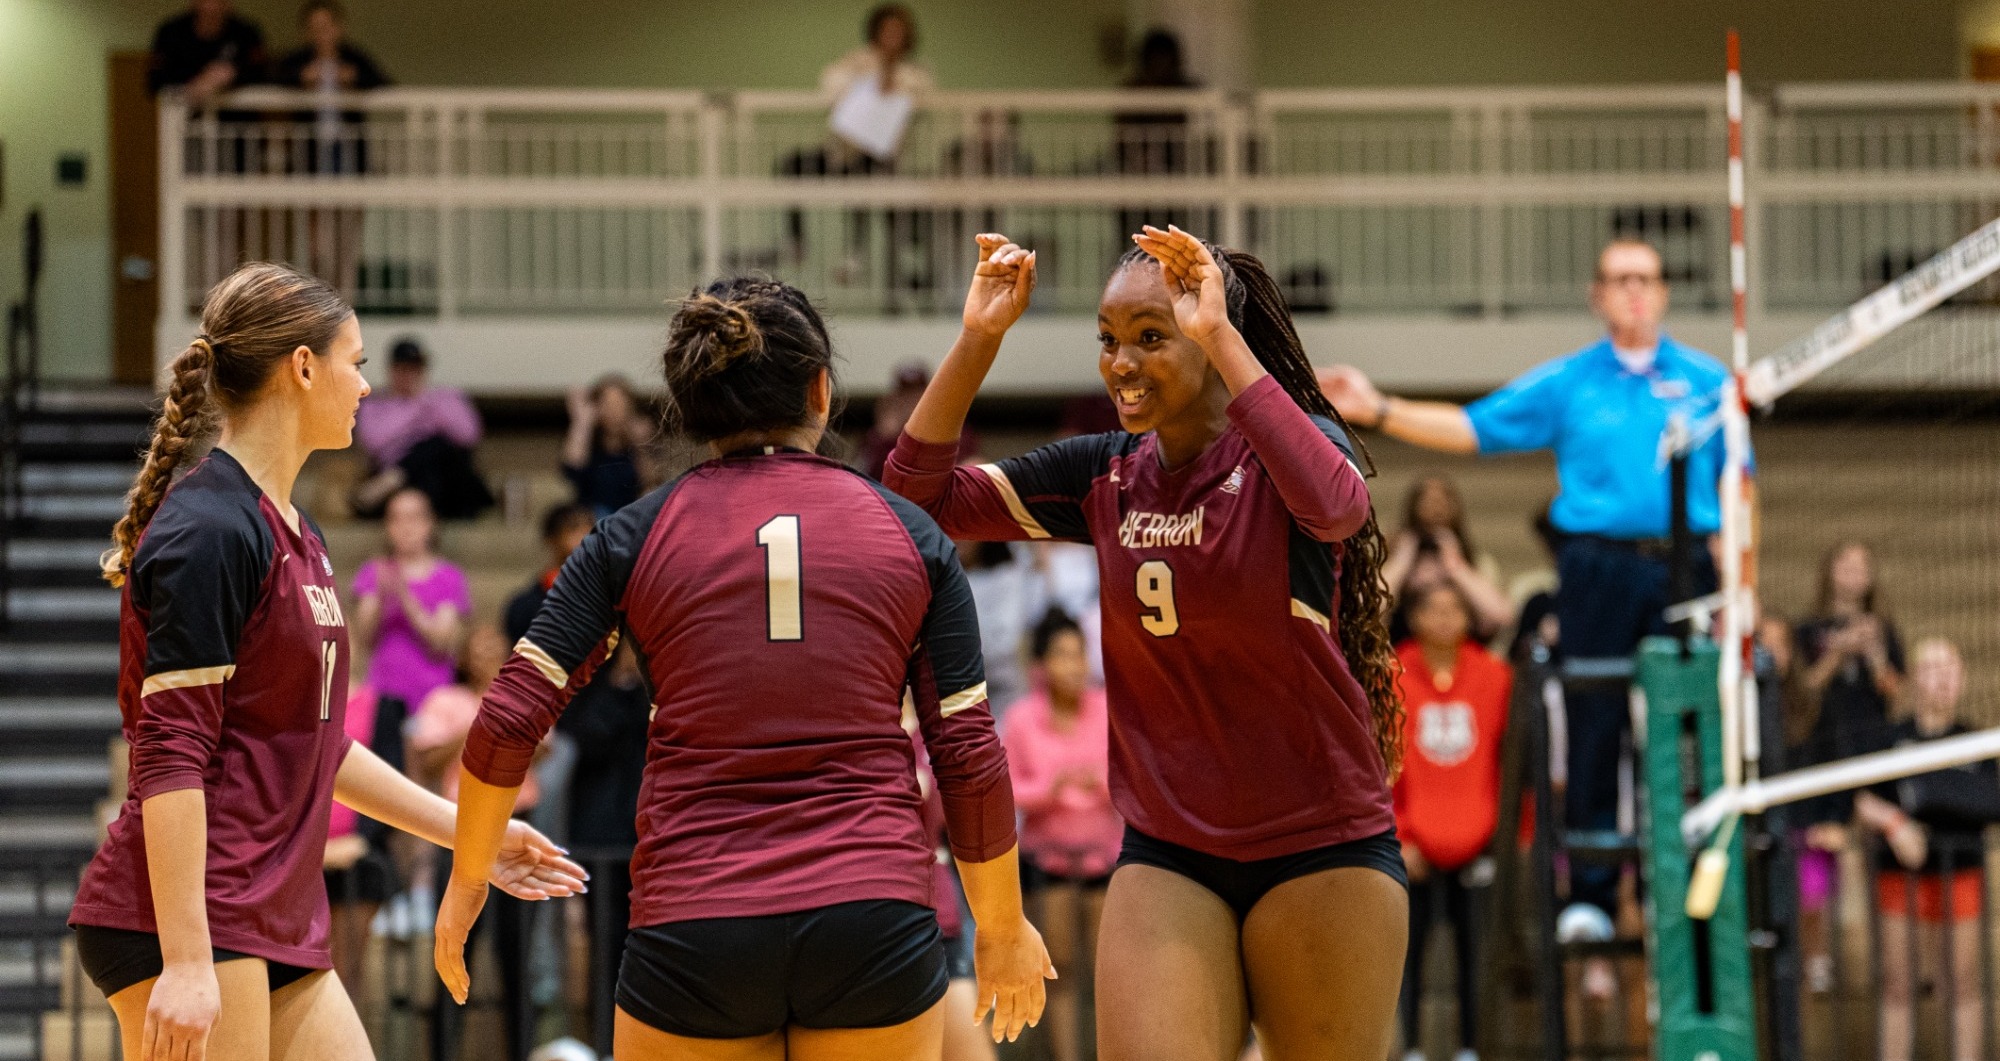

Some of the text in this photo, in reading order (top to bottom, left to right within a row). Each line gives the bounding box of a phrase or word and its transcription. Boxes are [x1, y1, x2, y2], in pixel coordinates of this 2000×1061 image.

[1118, 506, 1204, 549] HEBRON
[755, 513, 804, 642] 1
[1136, 559, 1179, 637] 9
[319, 638, 337, 722] 11
